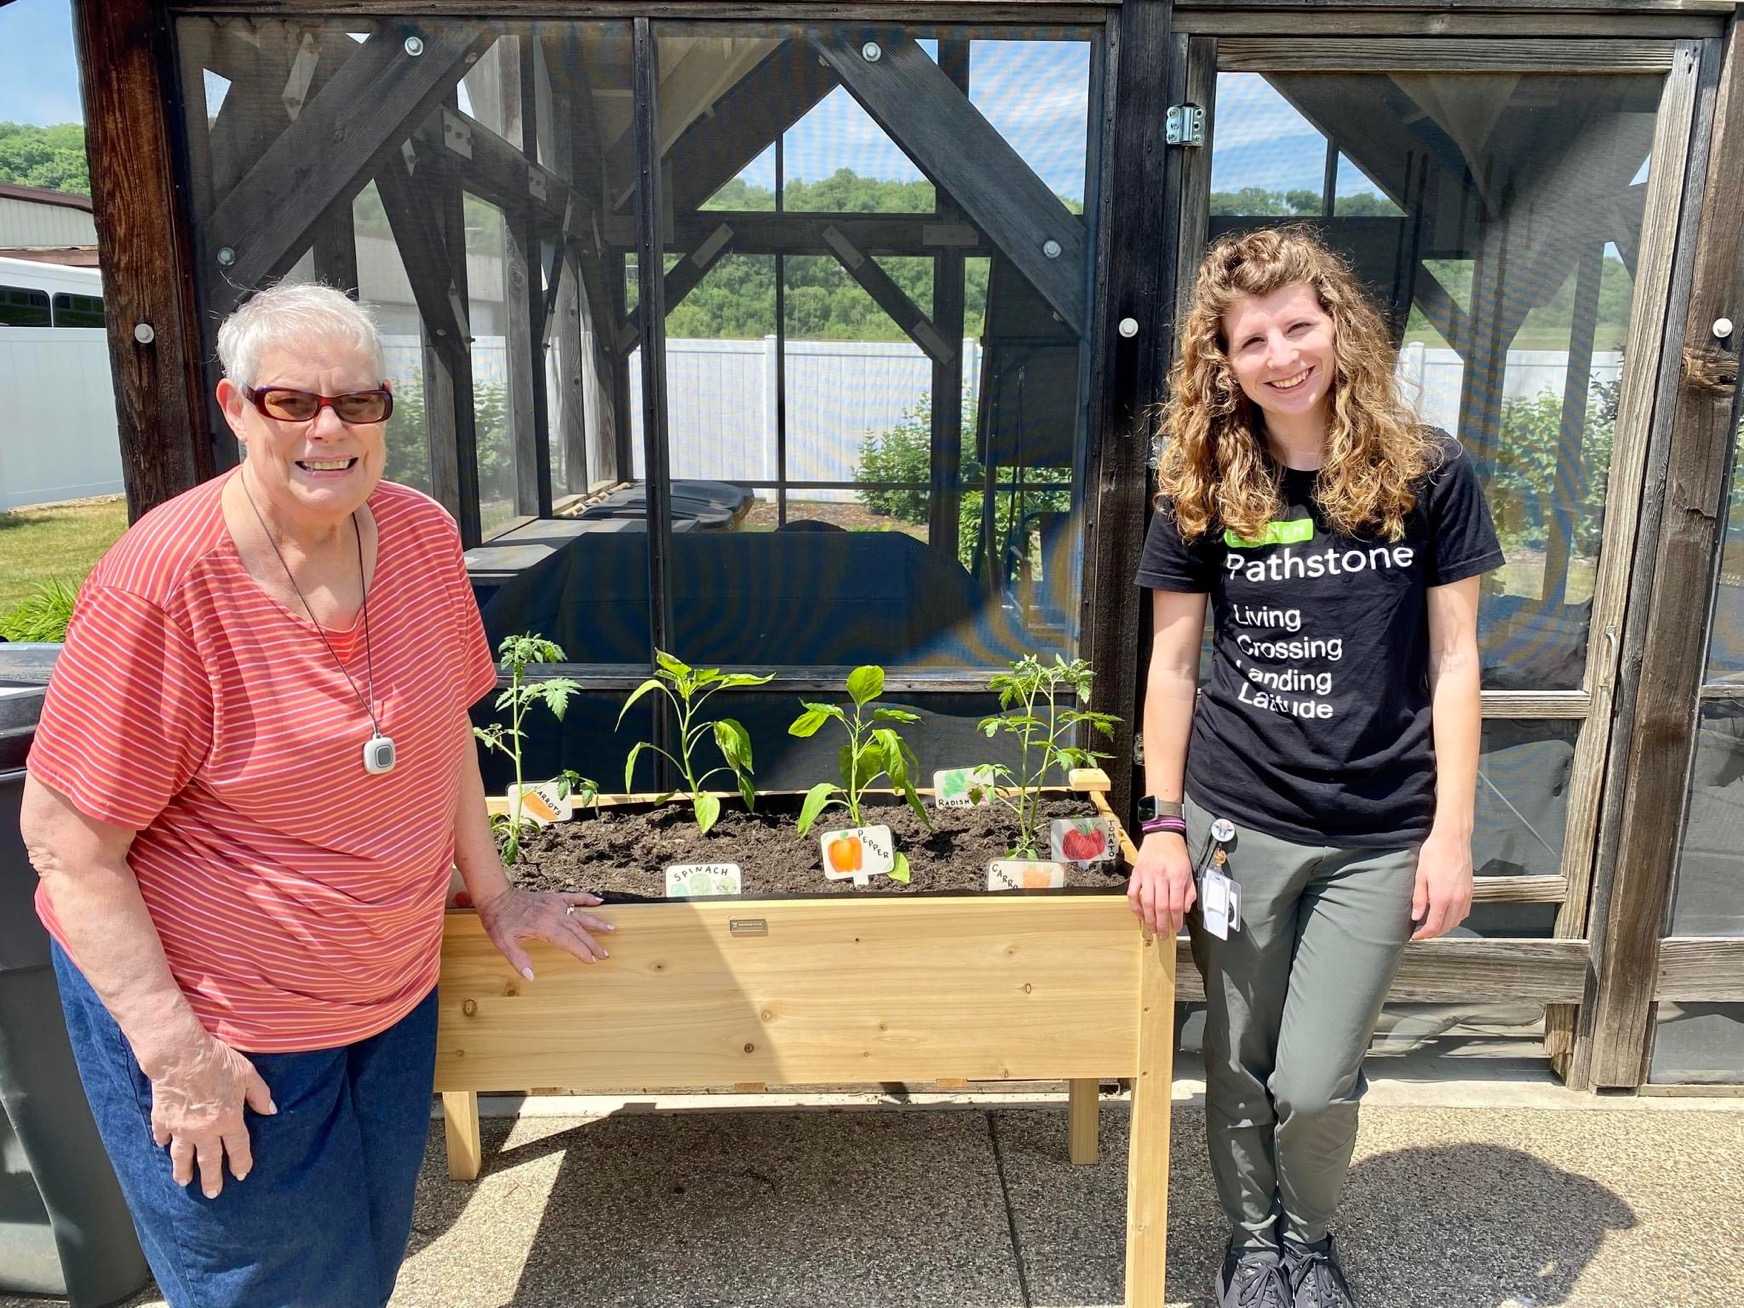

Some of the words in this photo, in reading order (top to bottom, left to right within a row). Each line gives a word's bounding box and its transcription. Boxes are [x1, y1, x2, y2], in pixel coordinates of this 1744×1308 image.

[1226, 546, 1414, 582] Pathstone
[1233, 603, 1301, 632] Living
[1237, 634, 1343, 662] Crossing
[1235, 659, 1332, 695] anding
[938, 798, 970, 807] RADISH
[857, 829, 889, 859] PEPPER
[1108, 819, 1116, 858] TOMATO
[673, 865, 729, 882] SPINACH
